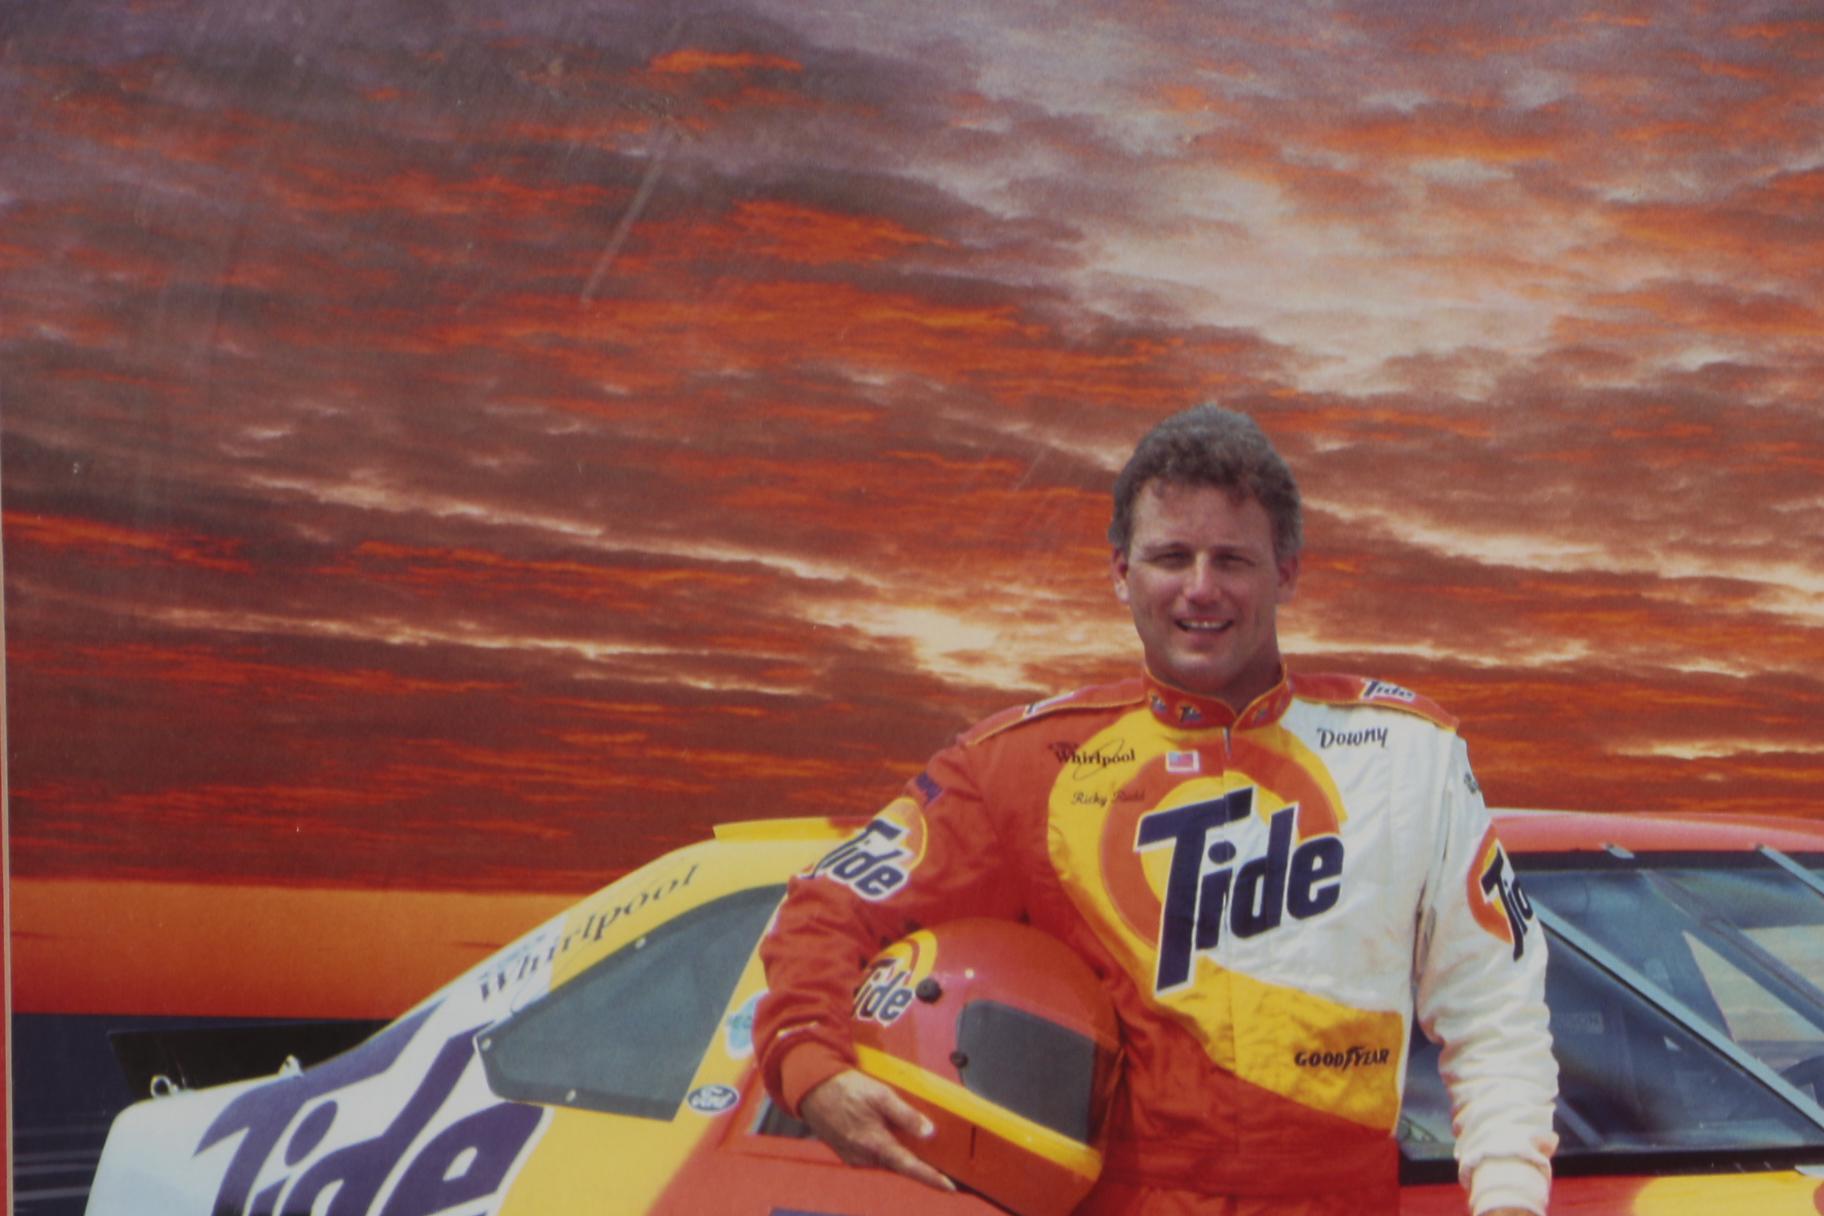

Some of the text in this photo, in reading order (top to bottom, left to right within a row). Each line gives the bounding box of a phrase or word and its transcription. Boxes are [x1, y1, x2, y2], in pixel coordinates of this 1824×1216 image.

[1048, 741, 1136, 769] Whirlpool
[1316, 727, 1389, 749] Downy
[809, 818, 905, 896] Tide
[1135, 787, 1345, 992] Tide
[480, 863, 699, 1002] Whirlpool
[1295, 1045, 1390, 1071] GOODYEAR
